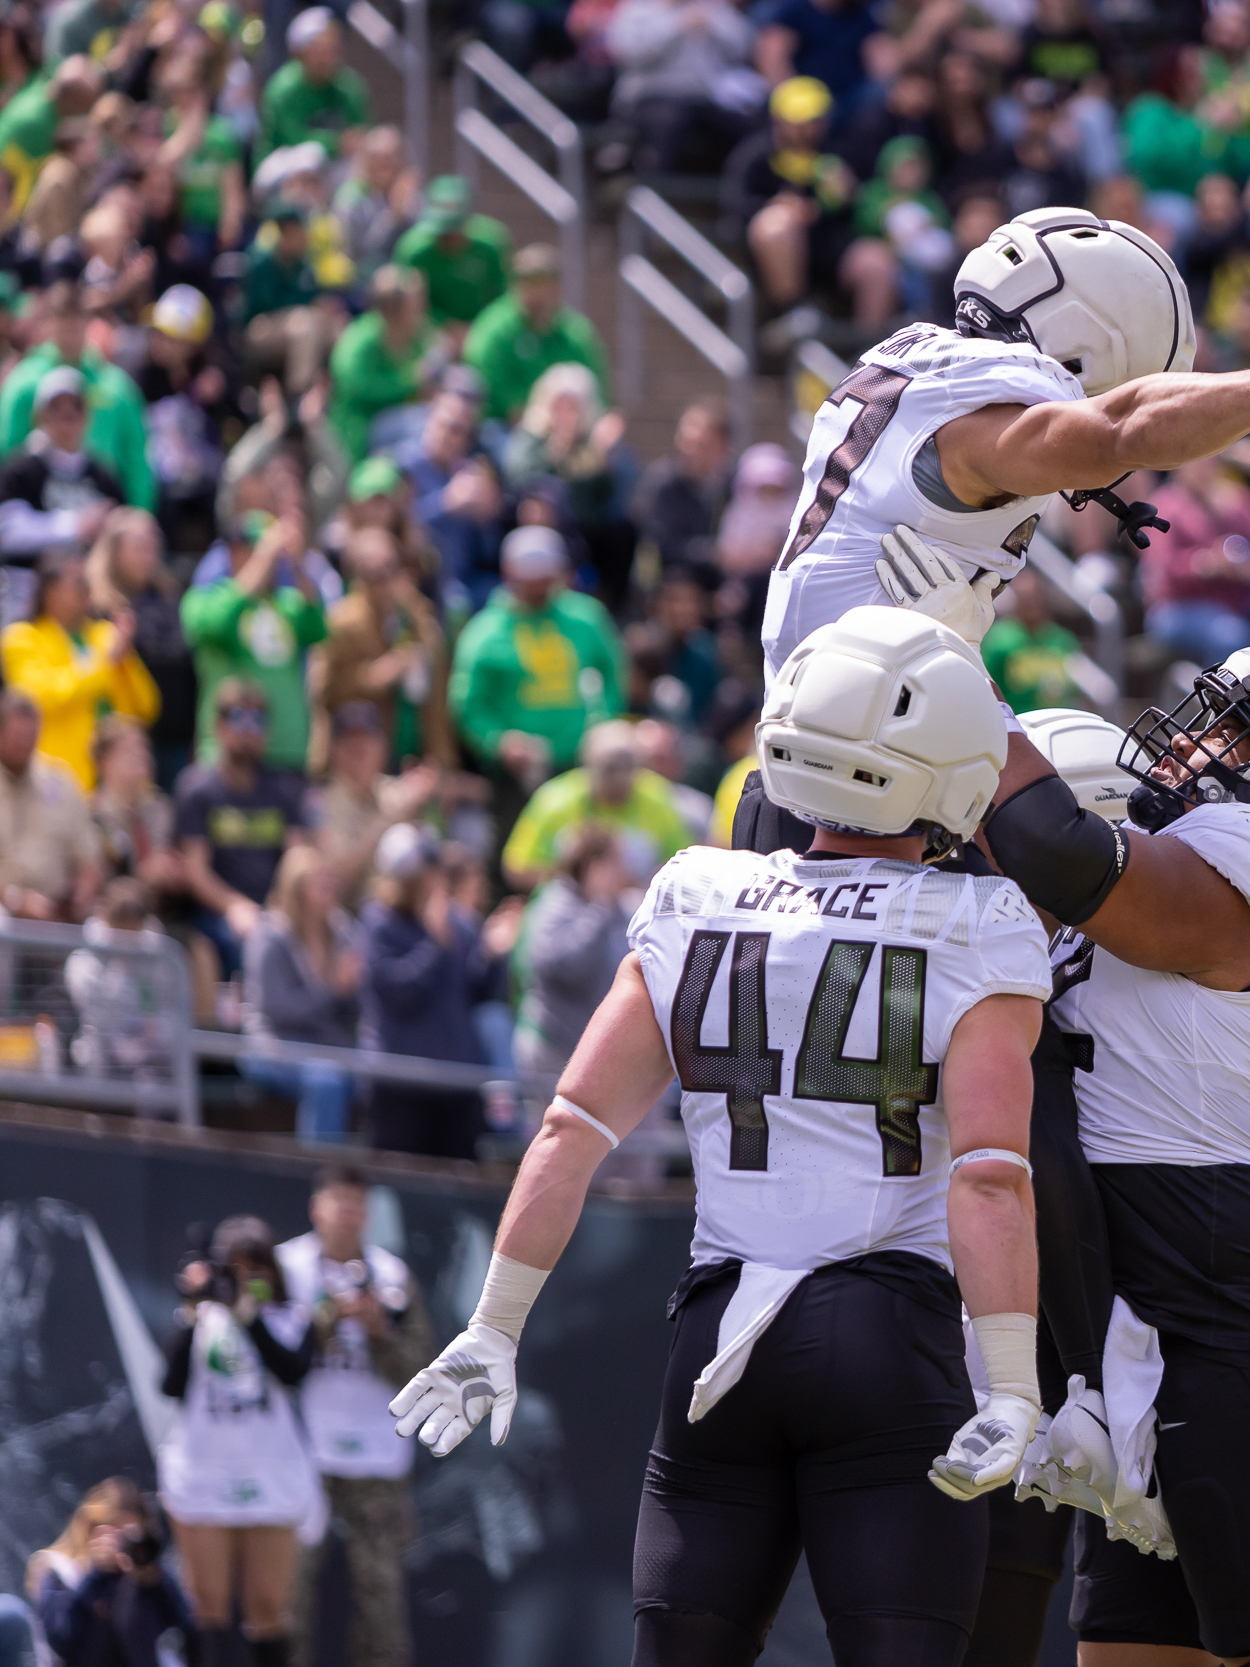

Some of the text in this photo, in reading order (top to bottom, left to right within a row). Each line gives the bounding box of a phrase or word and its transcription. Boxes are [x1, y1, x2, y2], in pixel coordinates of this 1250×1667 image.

[773, 360, 914, 571] 7
[803, 759, 833, 771] GUARDIAN
[1094, 792, 1129, 802] GUARDIAN
[735, 873, 890, 921] GRACE
[671, 930, 939, 1176] 44
